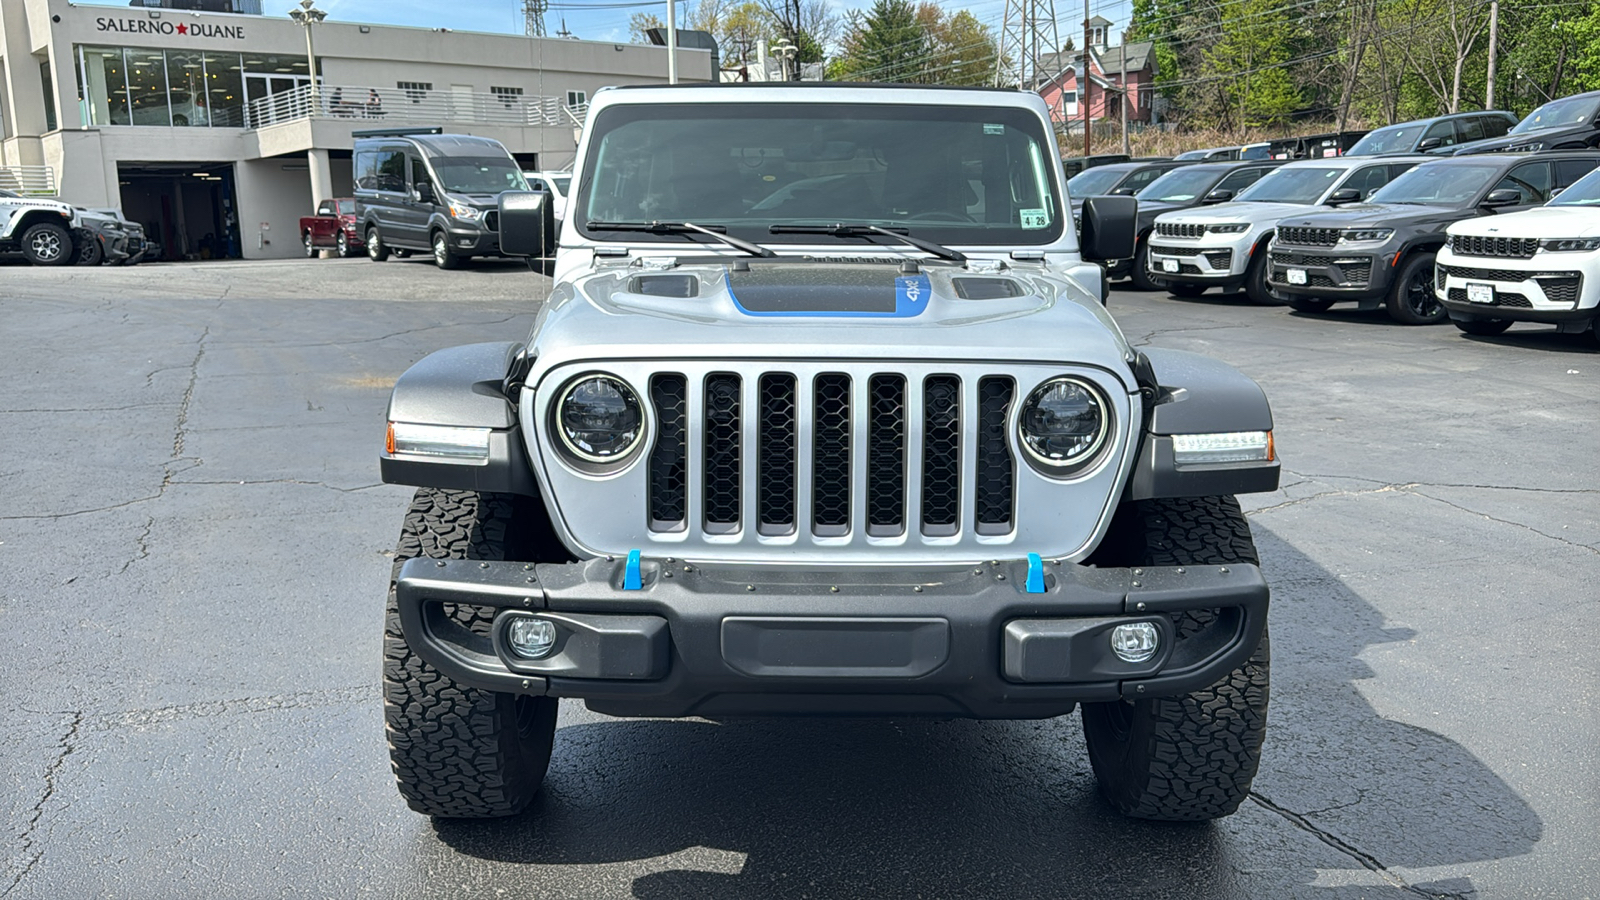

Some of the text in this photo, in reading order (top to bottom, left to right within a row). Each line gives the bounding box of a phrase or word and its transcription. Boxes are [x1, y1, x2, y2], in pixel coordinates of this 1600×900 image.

[96, 17, 245, 39] SALERNO DUANE
[1025, 216, 1046, 226] 4 28
